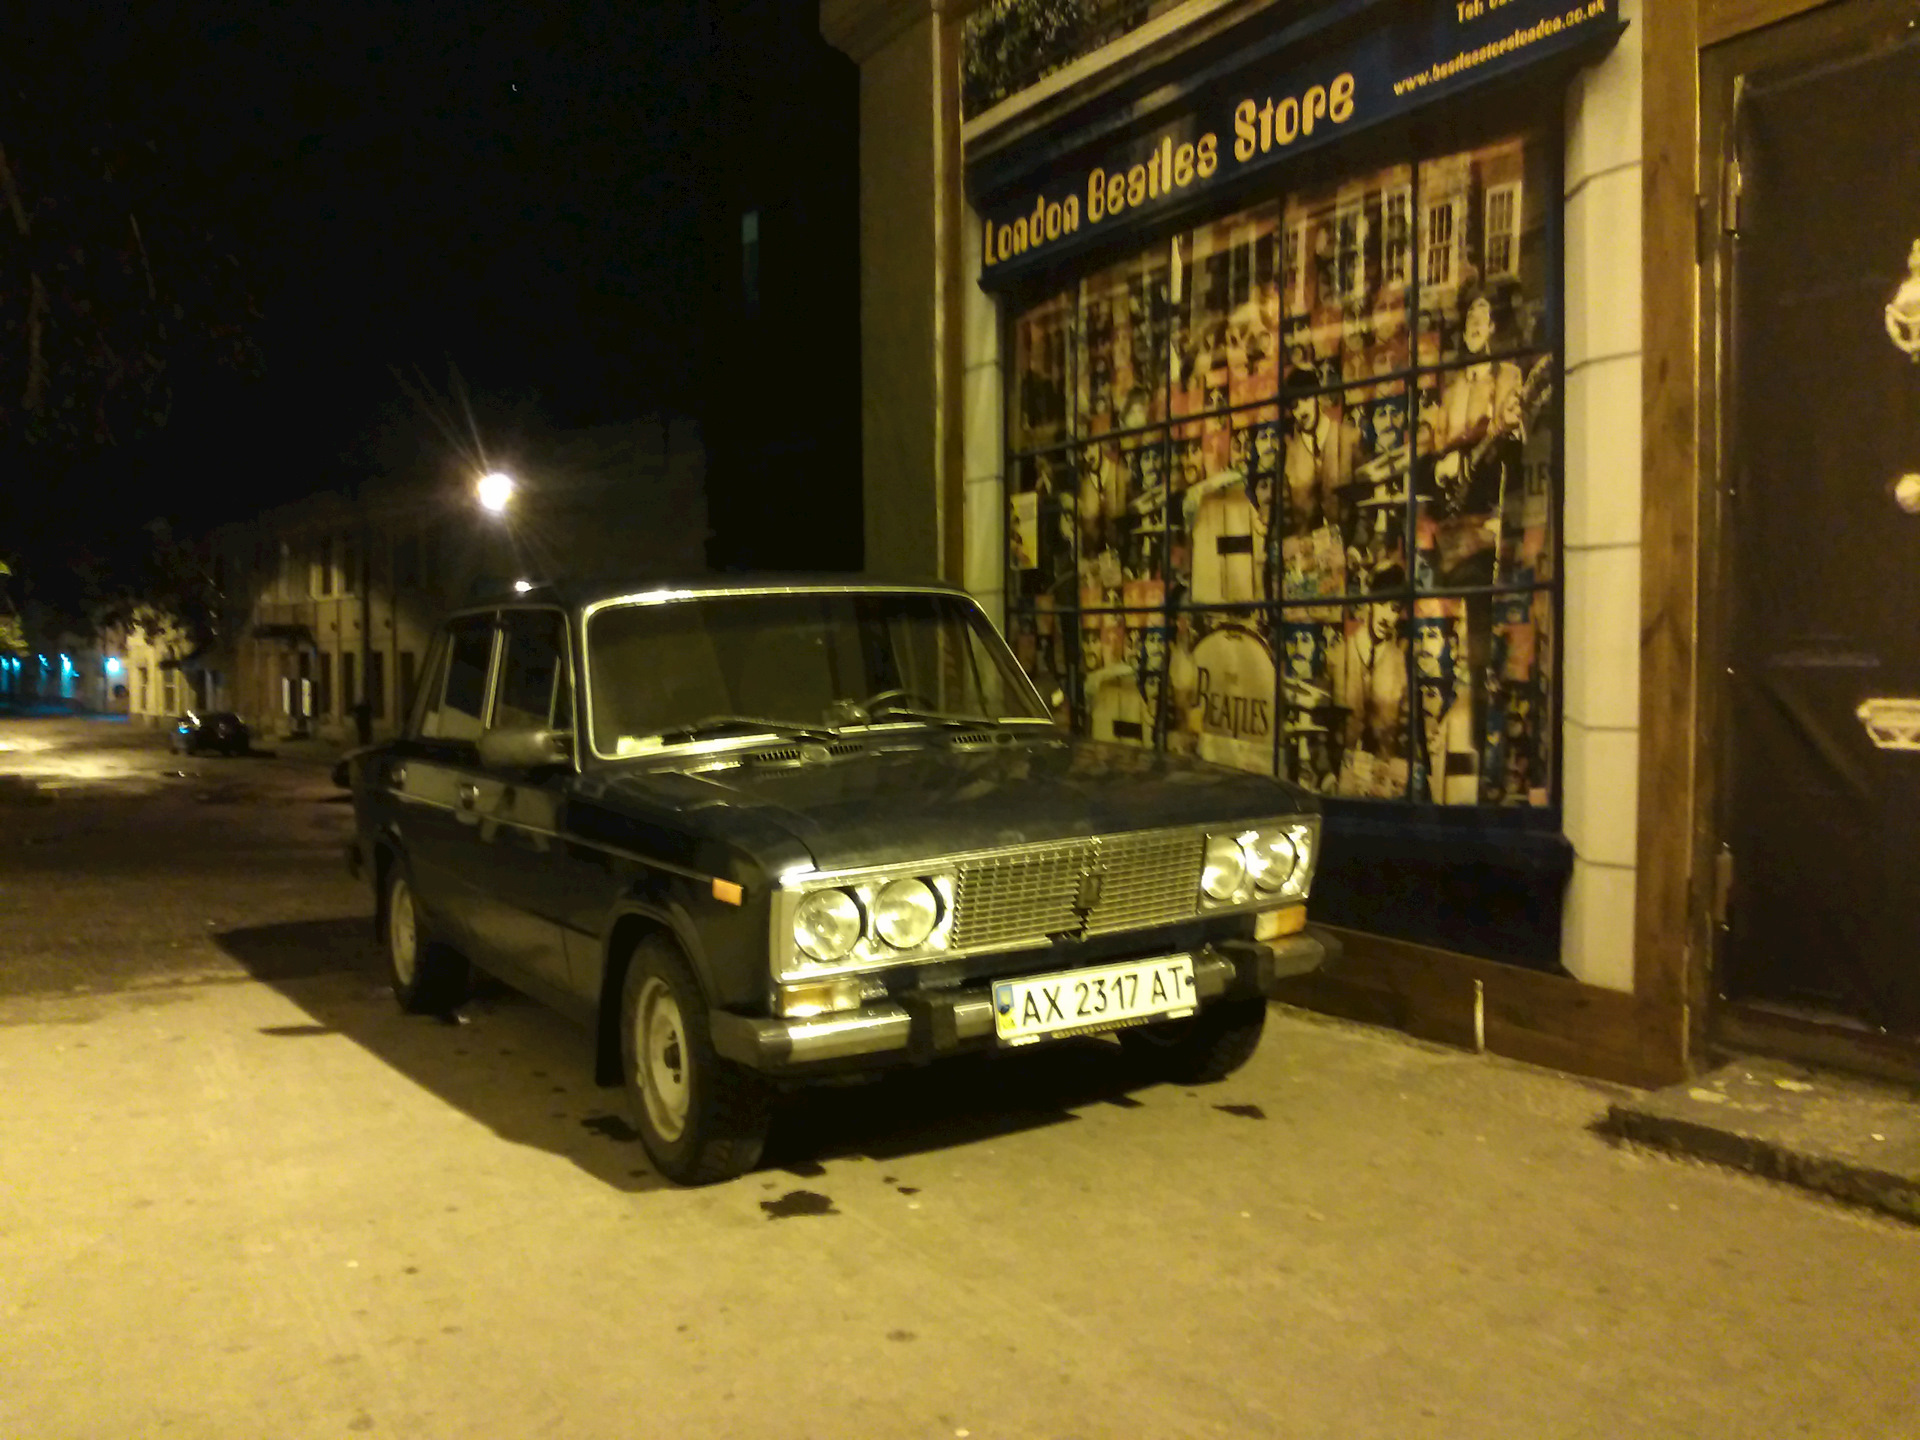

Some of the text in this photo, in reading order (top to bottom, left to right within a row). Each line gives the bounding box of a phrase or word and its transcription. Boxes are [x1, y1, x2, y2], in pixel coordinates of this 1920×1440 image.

[984, 72, 1356, 267] London Beatles Store
[1190, 666, 1269, 739] BEATLES
[1023, 966, 1184, 1026] AX 2317 AT
